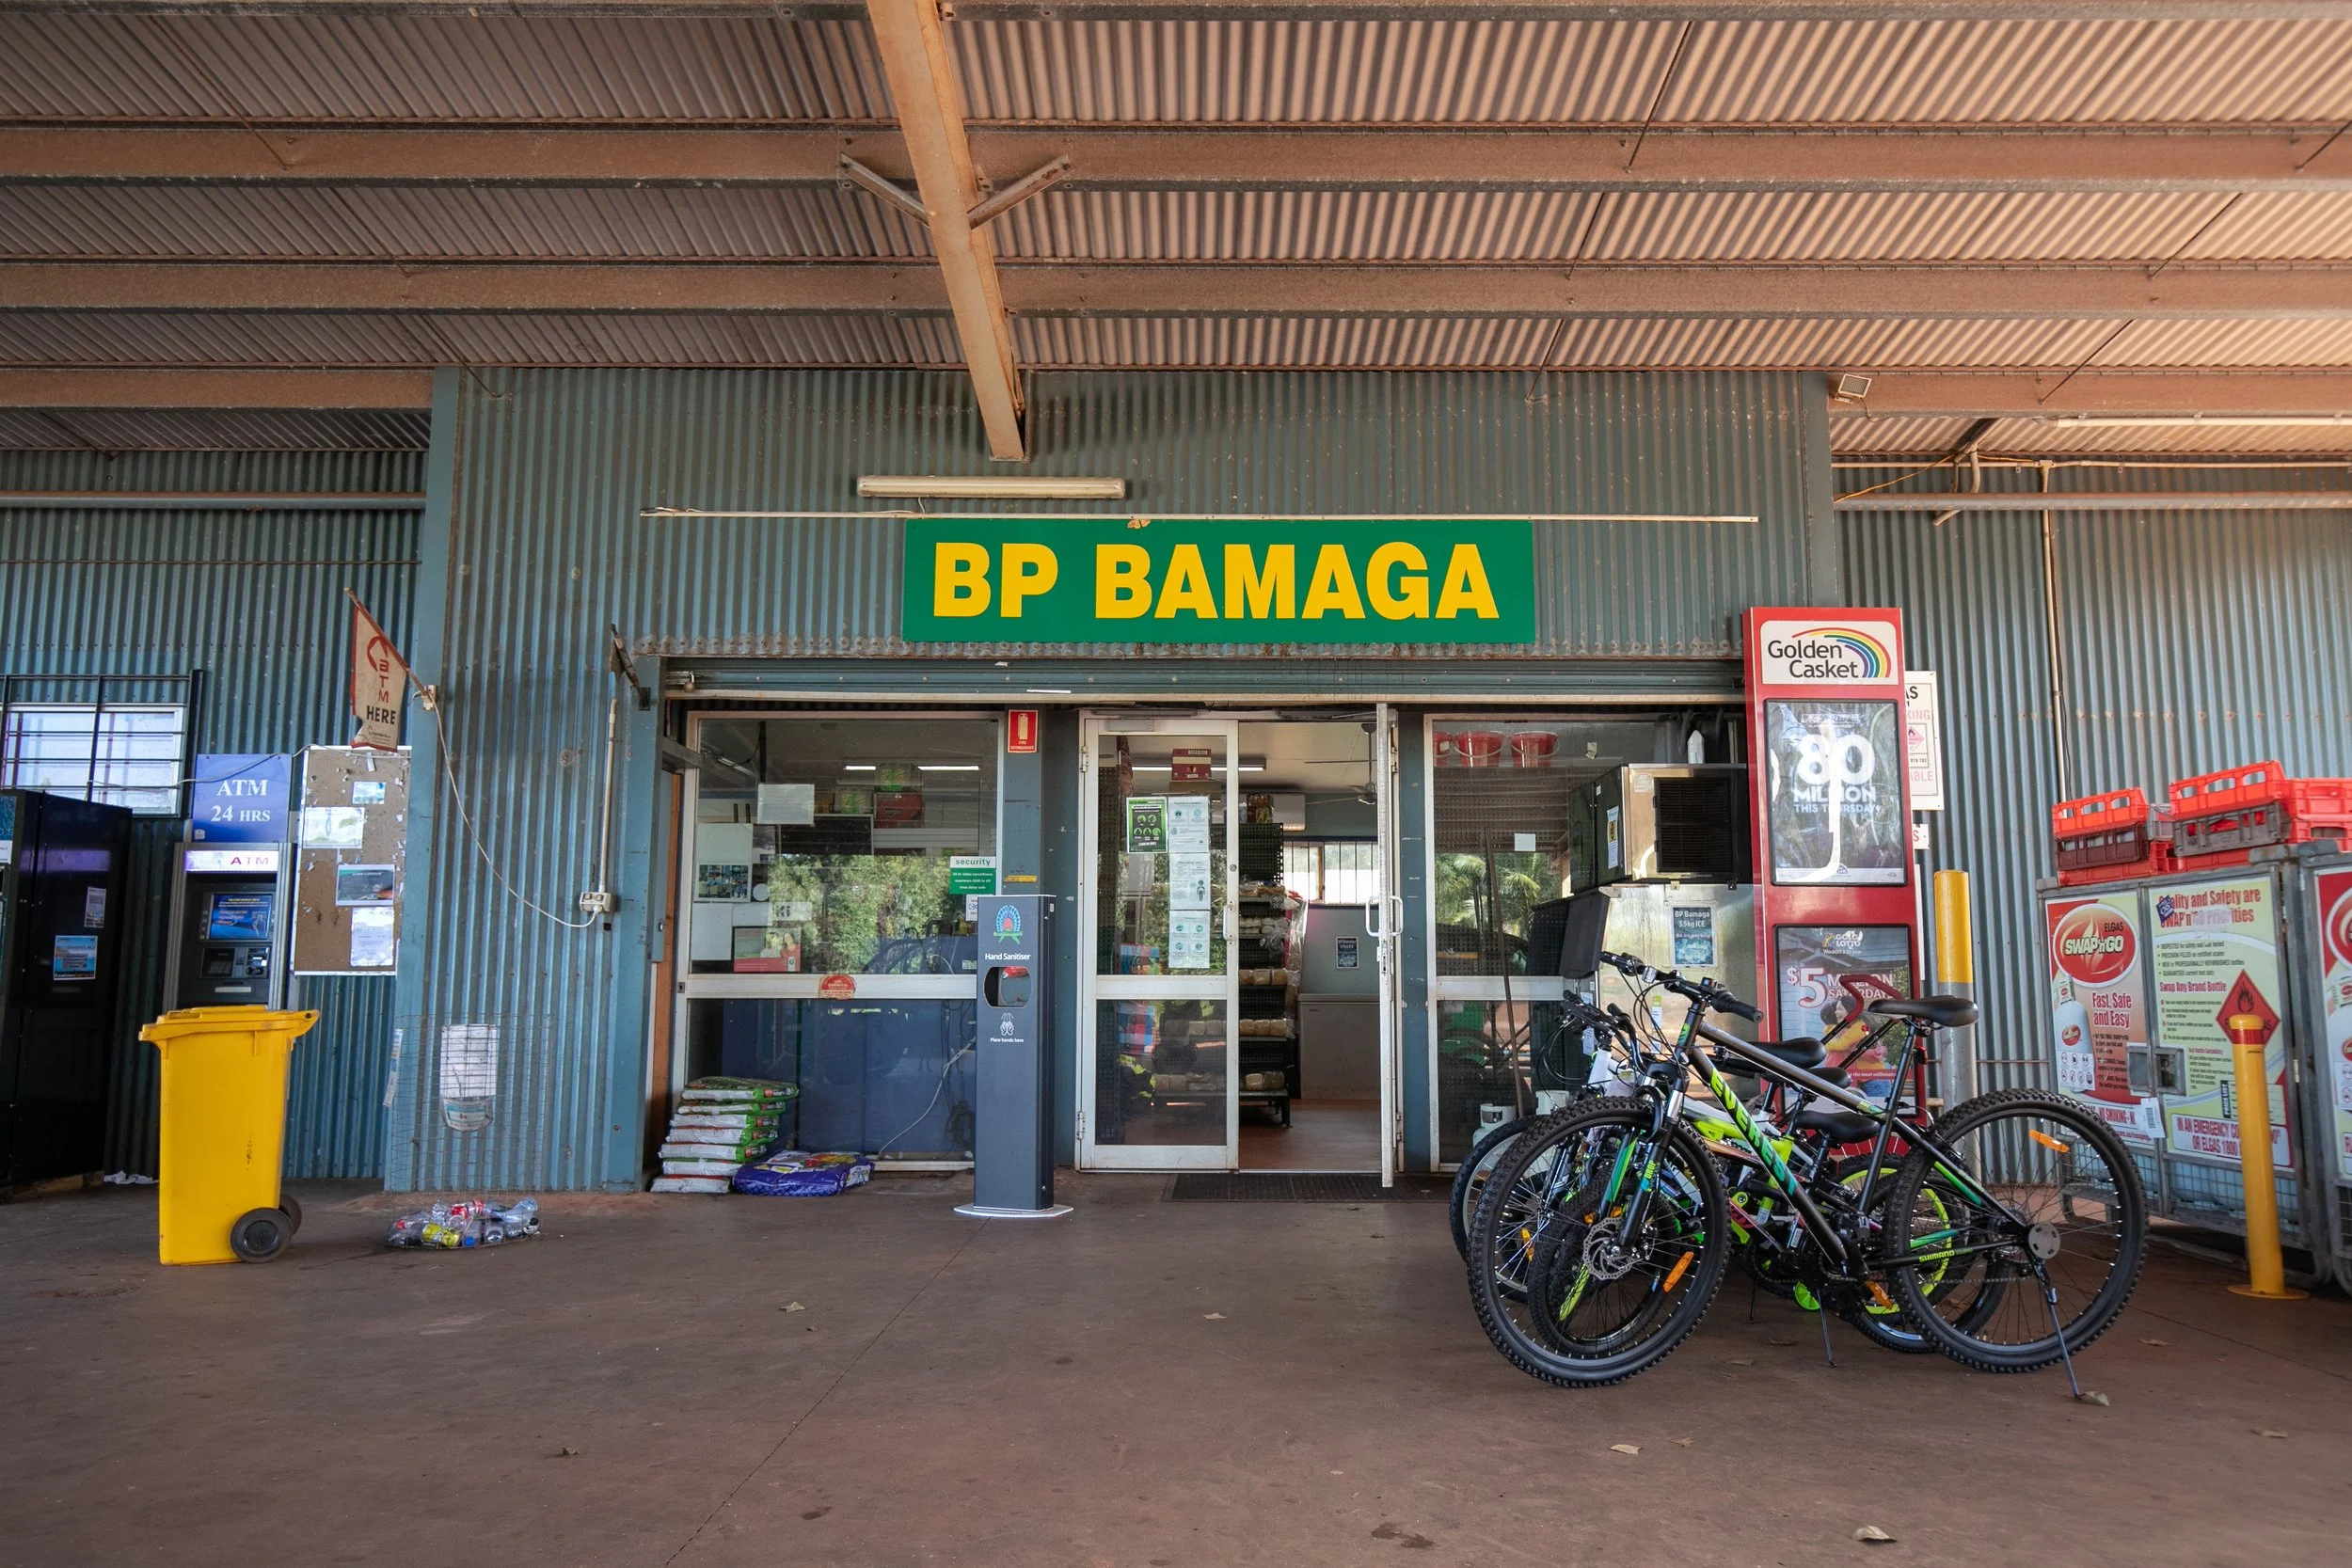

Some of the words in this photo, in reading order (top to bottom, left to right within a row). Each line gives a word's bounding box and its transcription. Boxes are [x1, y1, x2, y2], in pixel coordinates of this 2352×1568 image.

[933, 543, 1058, 618] BP
[1095, 542, 1500, 620] BAMAGA
[1768, 640, 1842, 658] Golden
[1789, 659, 1859, 678] Casket
[367, 705, 396, 725] HERE
[1797, 734, 1876, 784] 80
[216, 780, 268, 796] ATM
[1794, 786, 1877, 802] MILON
[211, 805, 233, 822] 24
[240, 810, 271, 822] HRS
[1794, 804, 1819, 813] THIS
[230, 857, 269, 865] ATM
[956, 858, 991, 866] security
[2191, 892, 2207, 907] and
[2209, 890, 2241, 905] Safety
[2243, 888, 2262, 903] are
[1684, 911, 1710, 919] Bamaga
[2104, 922, 2124, 933] ELGAS
[1003, 952, 1031, 960] Sanitiser
[1788, 966, 1827, 1008] $5
[2160, 982, 2175, 992] Swap
[2176, 982, 2186, 992] Any
[2188, 981, 2206, 991] Brand
[2207, 981, 2226, 991] Bottle
[2112, 991, 2132, 1008] Safe
[2094, 1011, 2108, 1025] and
[2110, 1010, 2130, 1028] Easy
[1710, 1068, 1799, 1196] EVEREST
[2177, 1117, 2185, 1131] IN
[2185, 1117, 2192, 1132] AN
[2194, 1119, 2230, 1138] EMERGENCY
[2192, 1136, 2201, 1150] OR
[2202, 1137, 2220, 1153] ELGAS
[2222, 1140, 2238, 1156] 1800
[1919, 1250, 1955, 1262] SHIMANO
